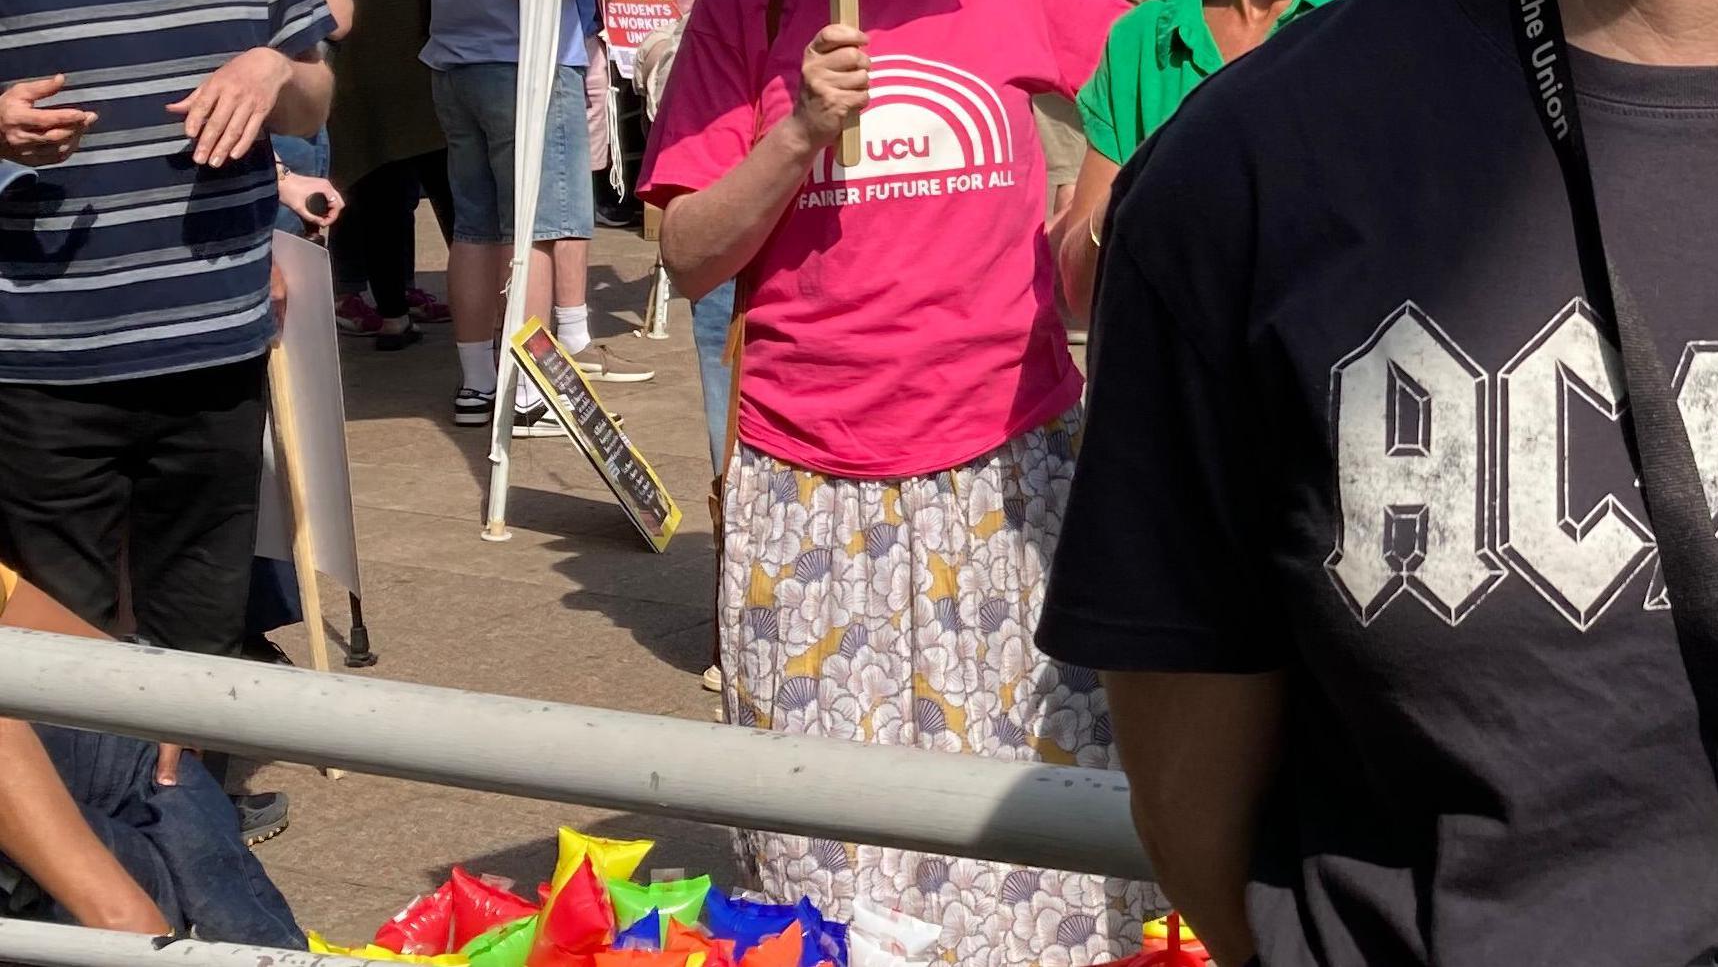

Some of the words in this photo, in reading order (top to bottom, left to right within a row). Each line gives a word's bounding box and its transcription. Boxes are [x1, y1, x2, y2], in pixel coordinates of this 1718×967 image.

[607, 2, 672, 16] STUDENTS
[608, 16, 618, 29] &
[1531, 39, 1569, 141] Union
[799, 187, 860, 210] FAIRER
[865, 179, 941, 202] FUTURE
[946, 174, 983, 194] FOR
[988, 170, 1014, 188] ALL
